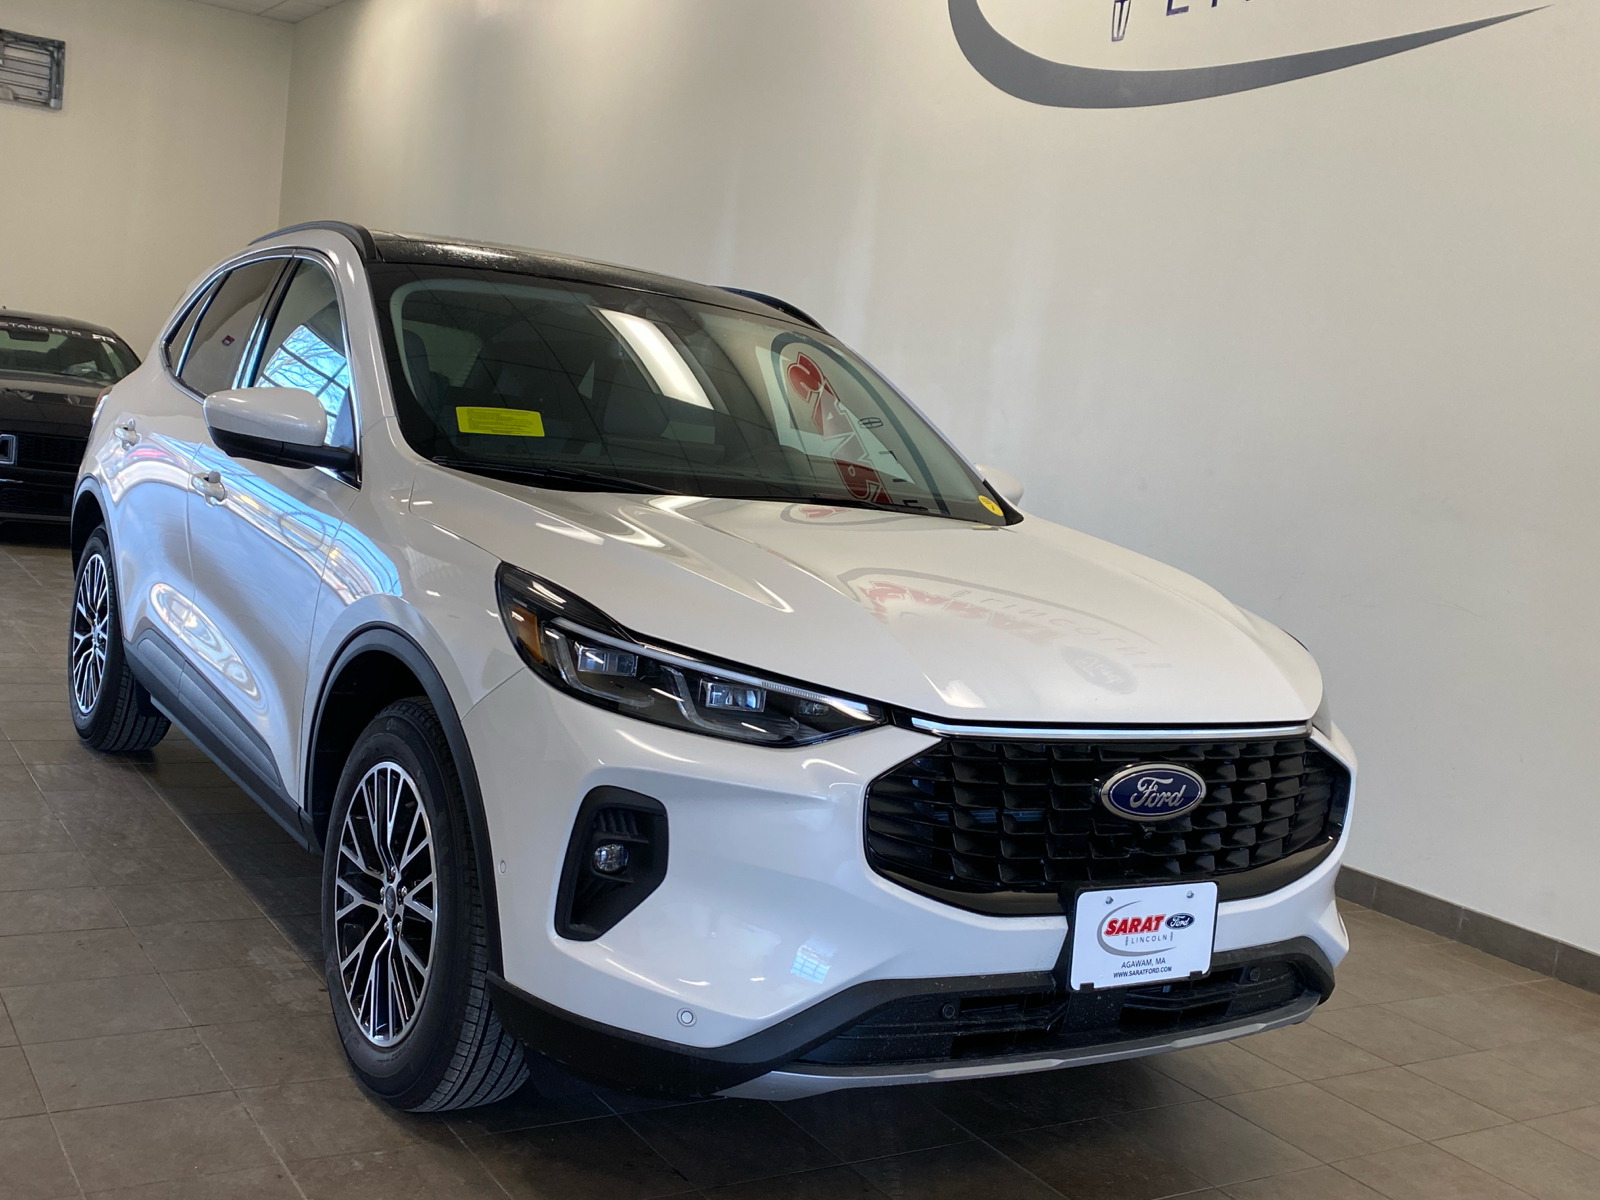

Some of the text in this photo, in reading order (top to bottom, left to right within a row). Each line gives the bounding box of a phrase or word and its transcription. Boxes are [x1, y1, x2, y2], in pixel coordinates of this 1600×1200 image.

[52, 328, 81, 336] RTR
[1130, 776, 1187, 808] Ford
[1104, 914, 1167, 937] SARAT
[1131, 934, 1168, 945] LINCOLN
[1121, 957, 1166, 969] AGAWAM, MA
[1113, 966, 1172, 979] WWW.SARATFORD.COM
